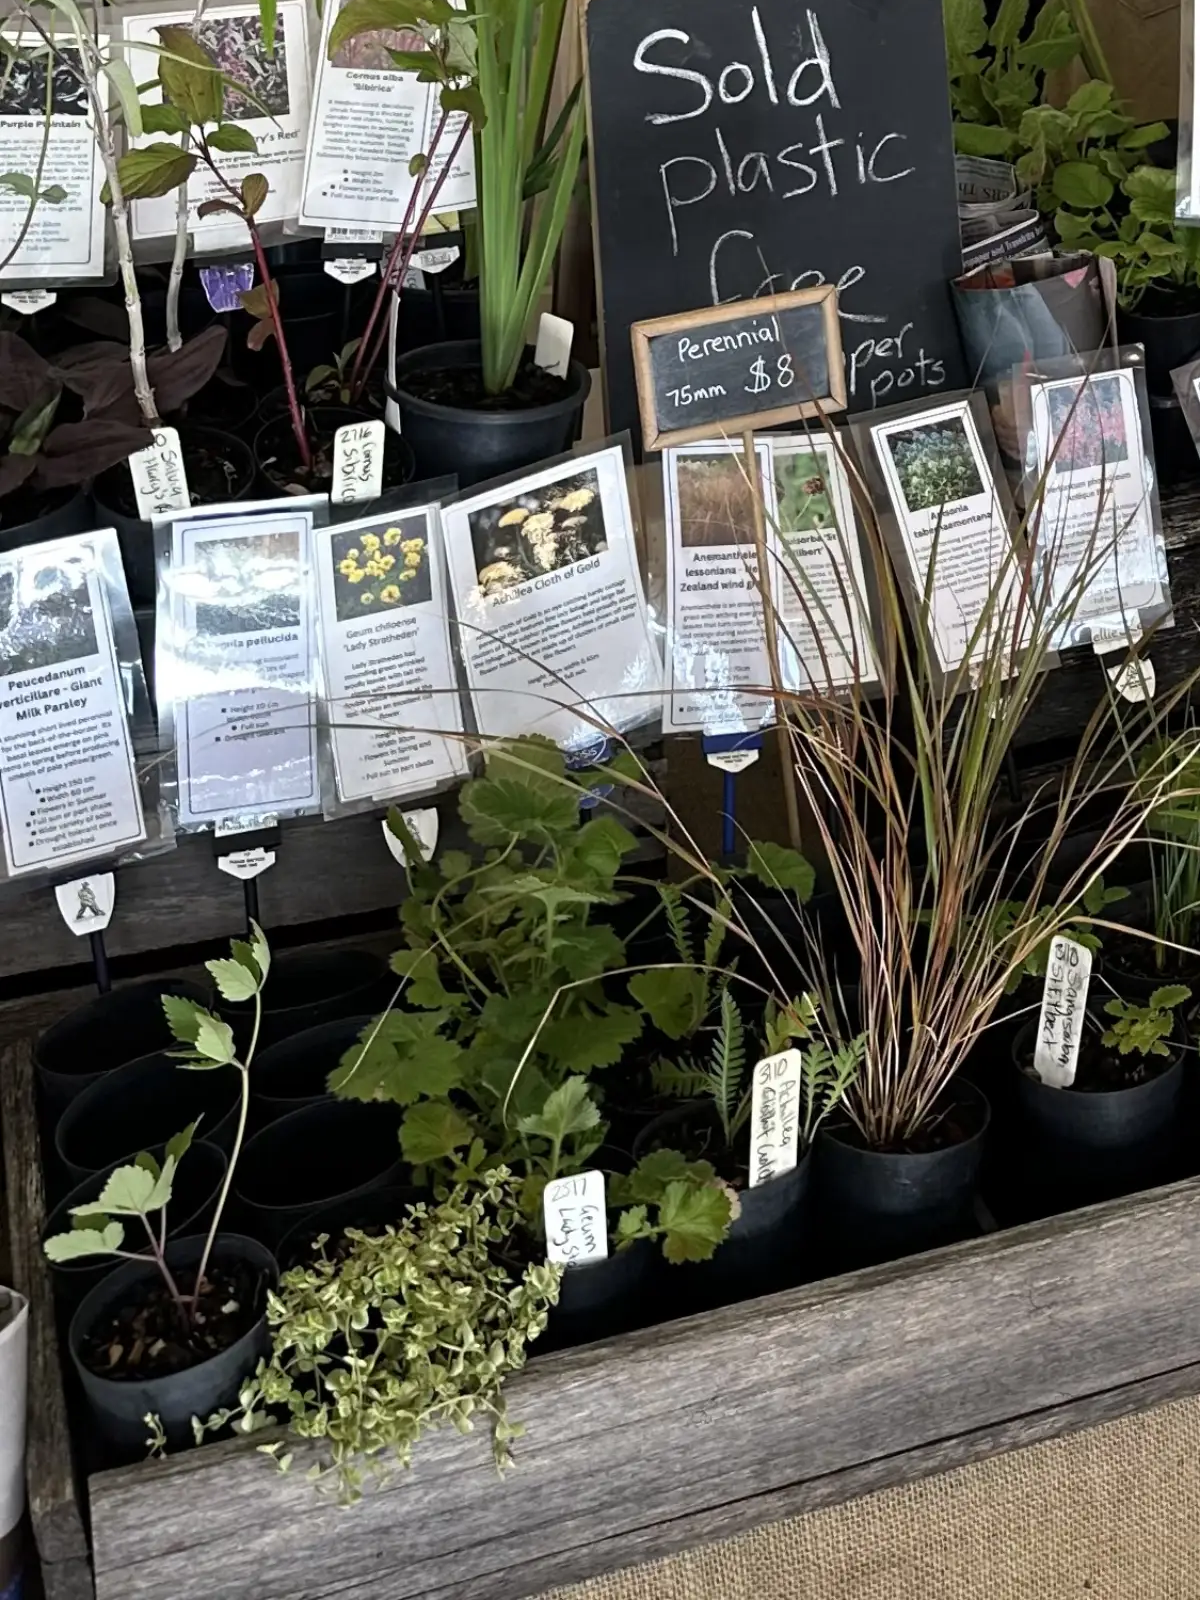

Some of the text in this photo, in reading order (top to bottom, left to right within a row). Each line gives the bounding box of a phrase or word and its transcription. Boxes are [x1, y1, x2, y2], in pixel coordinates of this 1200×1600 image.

[633, 5, 841, 125] Sold
[659, 113, 916, 257] plastic
[677, 314, 781, 361] Perennial
[666, 353, 795, 407] 75mm $8
[870, 348, 946, 407] pots
[534, 573, 562, 591] Cloth
[564, 568, 575, 580] of
[576, 557, 601, 574] Gold
[680, 581, 719, 592] Zealand
[346, 627, 373, 639] Geum
[8, 666, 86, 691] Peucedanum
[70, 676, 103, 692] Giant
[16, 697, 88, 721] Milk Parsley
